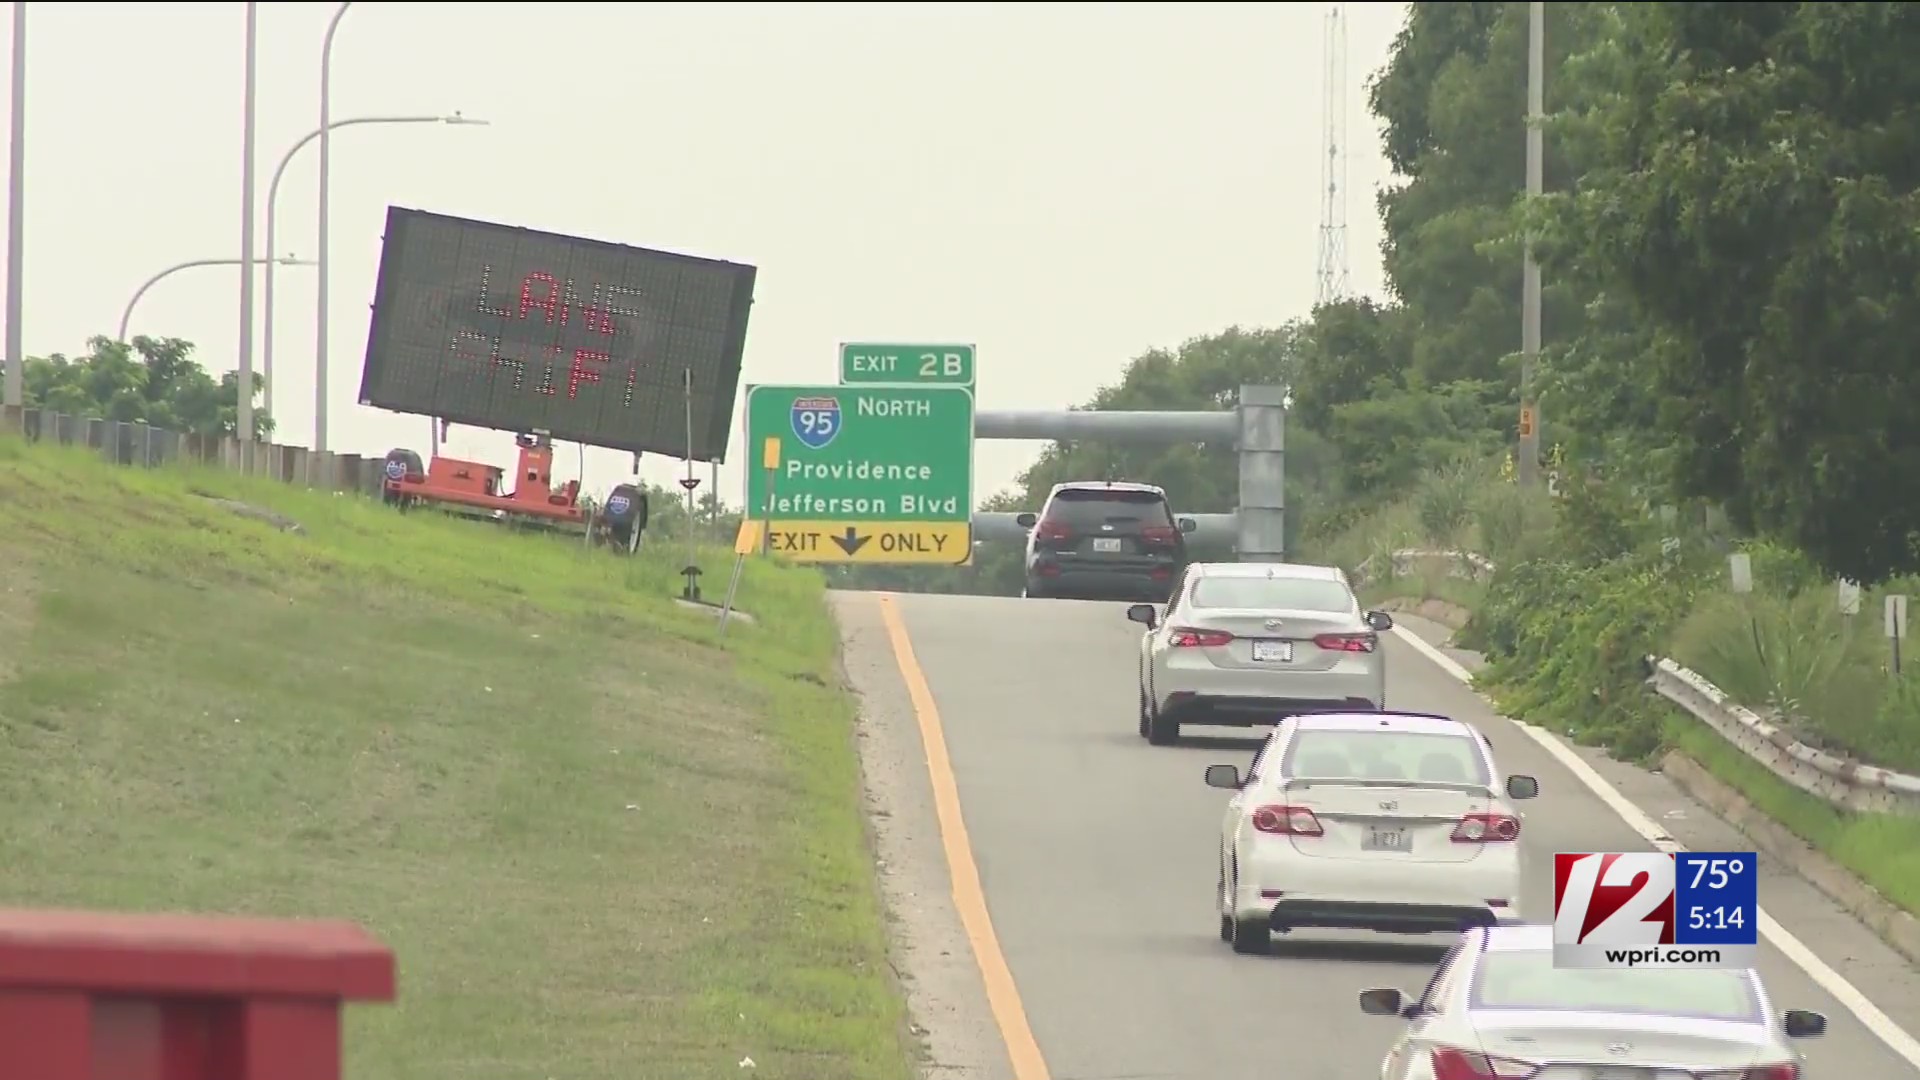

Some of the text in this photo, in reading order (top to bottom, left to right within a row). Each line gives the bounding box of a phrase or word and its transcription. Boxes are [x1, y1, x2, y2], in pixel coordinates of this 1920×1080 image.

[477, 263, 643, 334] LANE
[852, 353, 963, 376] EXIT 2B
[858, 397, 931, 416] NORTH
[800, 411, 833, 435] 95
[786, 460, 932, 480] Providence
[761, 493, 957, 514] Jefferson Blvd
[769, 532, 949, 552] EXIT ONLY
